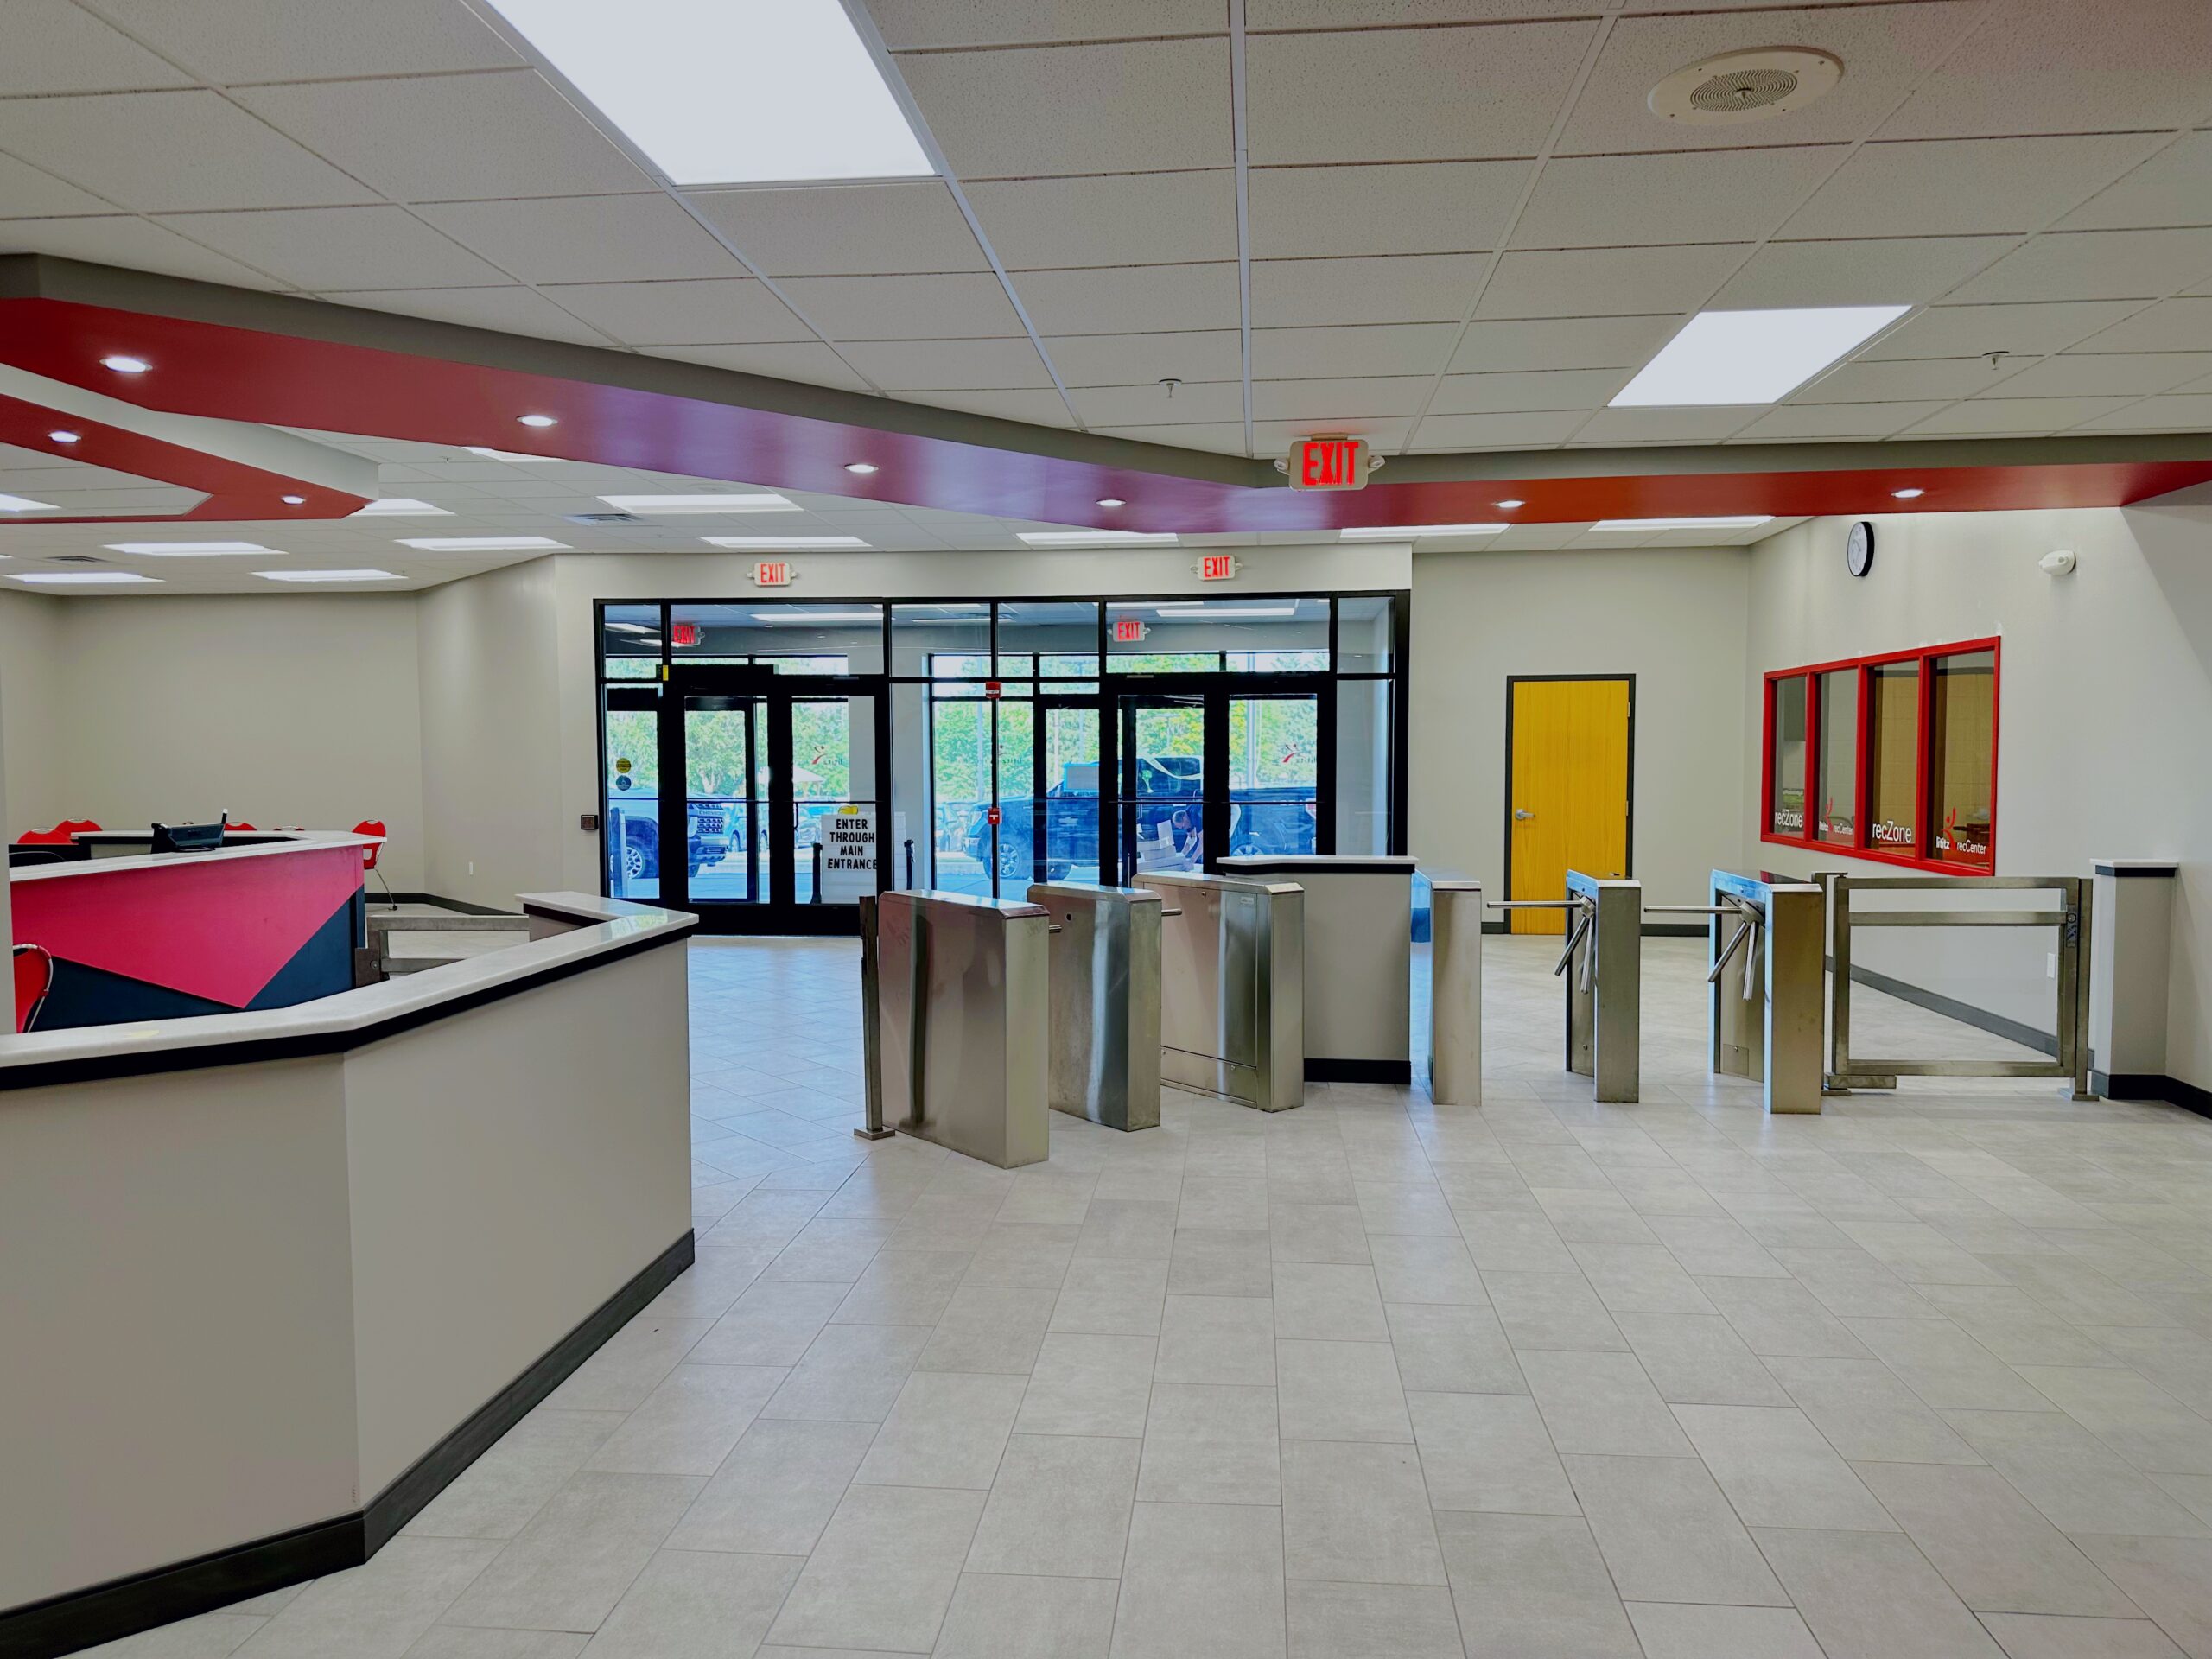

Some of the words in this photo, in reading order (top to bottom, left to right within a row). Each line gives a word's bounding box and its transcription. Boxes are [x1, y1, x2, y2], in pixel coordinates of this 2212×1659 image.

[1302, 442, 1359, 486] EXIT
[760, 563, 785, 582] EXIT
[1204, 556, 1230, 577] EXIT
[673, 625, 695, 644] EXIT
[1117, 622, 1140, 640] EXIT
[836, 818, 868, 830] ENTER
[1775, 810, 1803, 828] recZone
[830, 832, 874, 843] THROUGH
[1872, 820, 1912, 843] recZone
[840, 845, 863, 856] MAIN
[1956, 839, 1986, 855] recCenter
[827, 858, 877, 869] ENTRANCE
